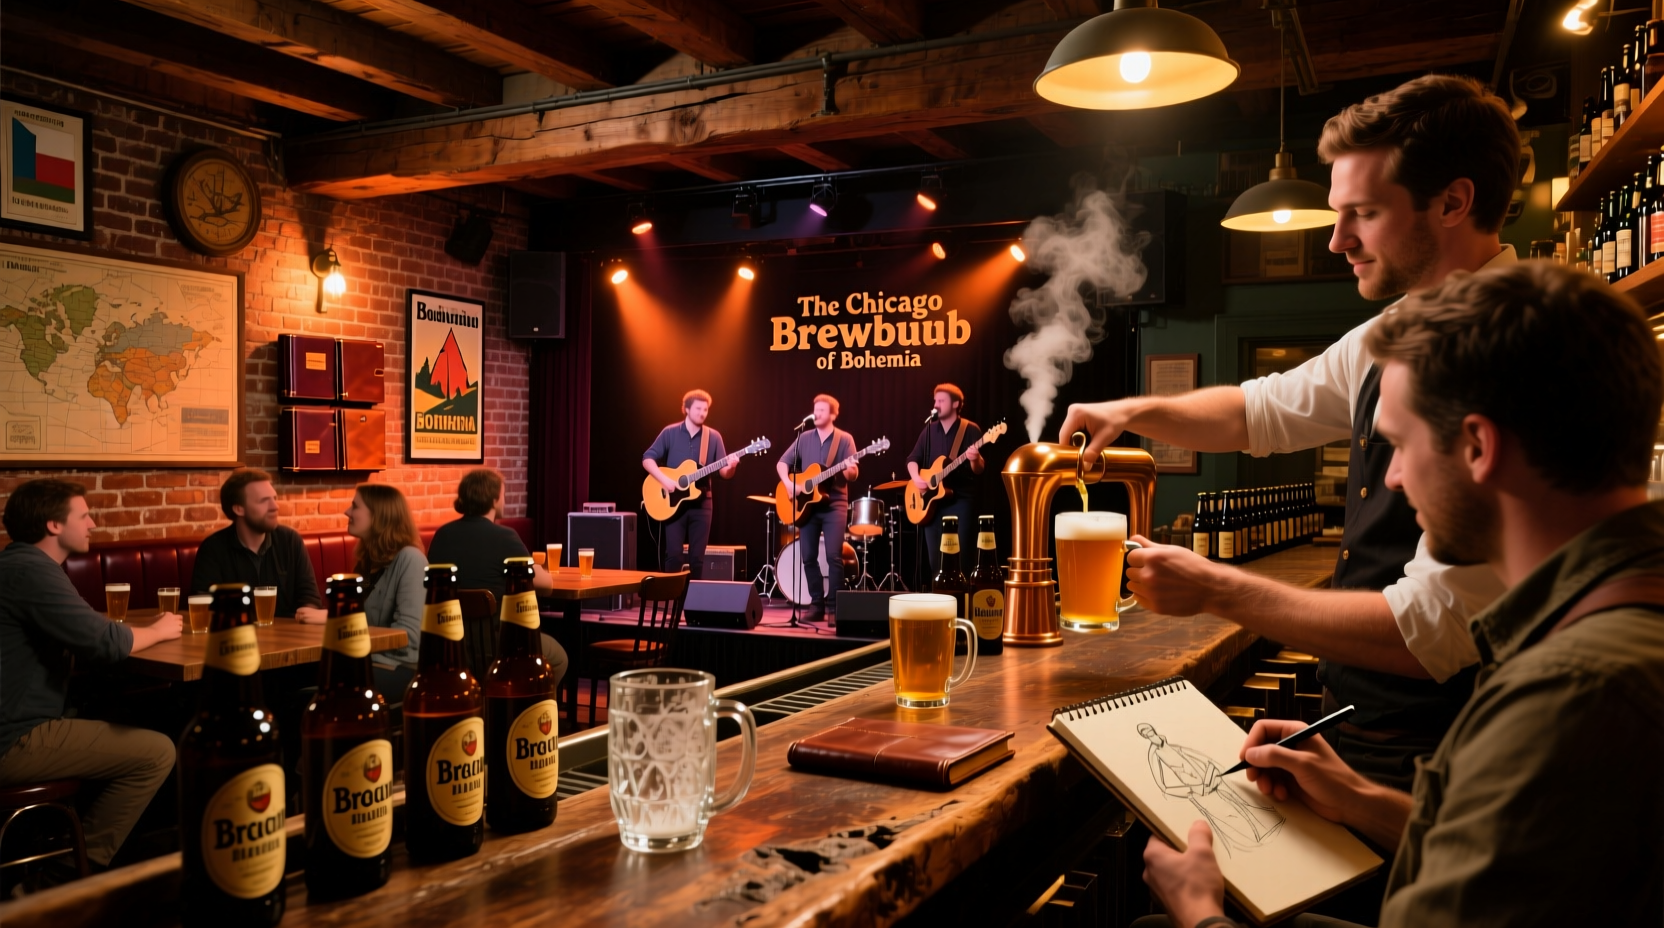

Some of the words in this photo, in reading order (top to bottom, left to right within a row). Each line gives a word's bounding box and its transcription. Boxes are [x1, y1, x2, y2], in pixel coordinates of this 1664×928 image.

[797, 295, 840, 317] The
[845, 291, 943, 319] Chicago
[769, 309, 972, 351] Brewbuub
[816, 351, 837, 370] of
[840, 350, 922, 369] Bohemia
